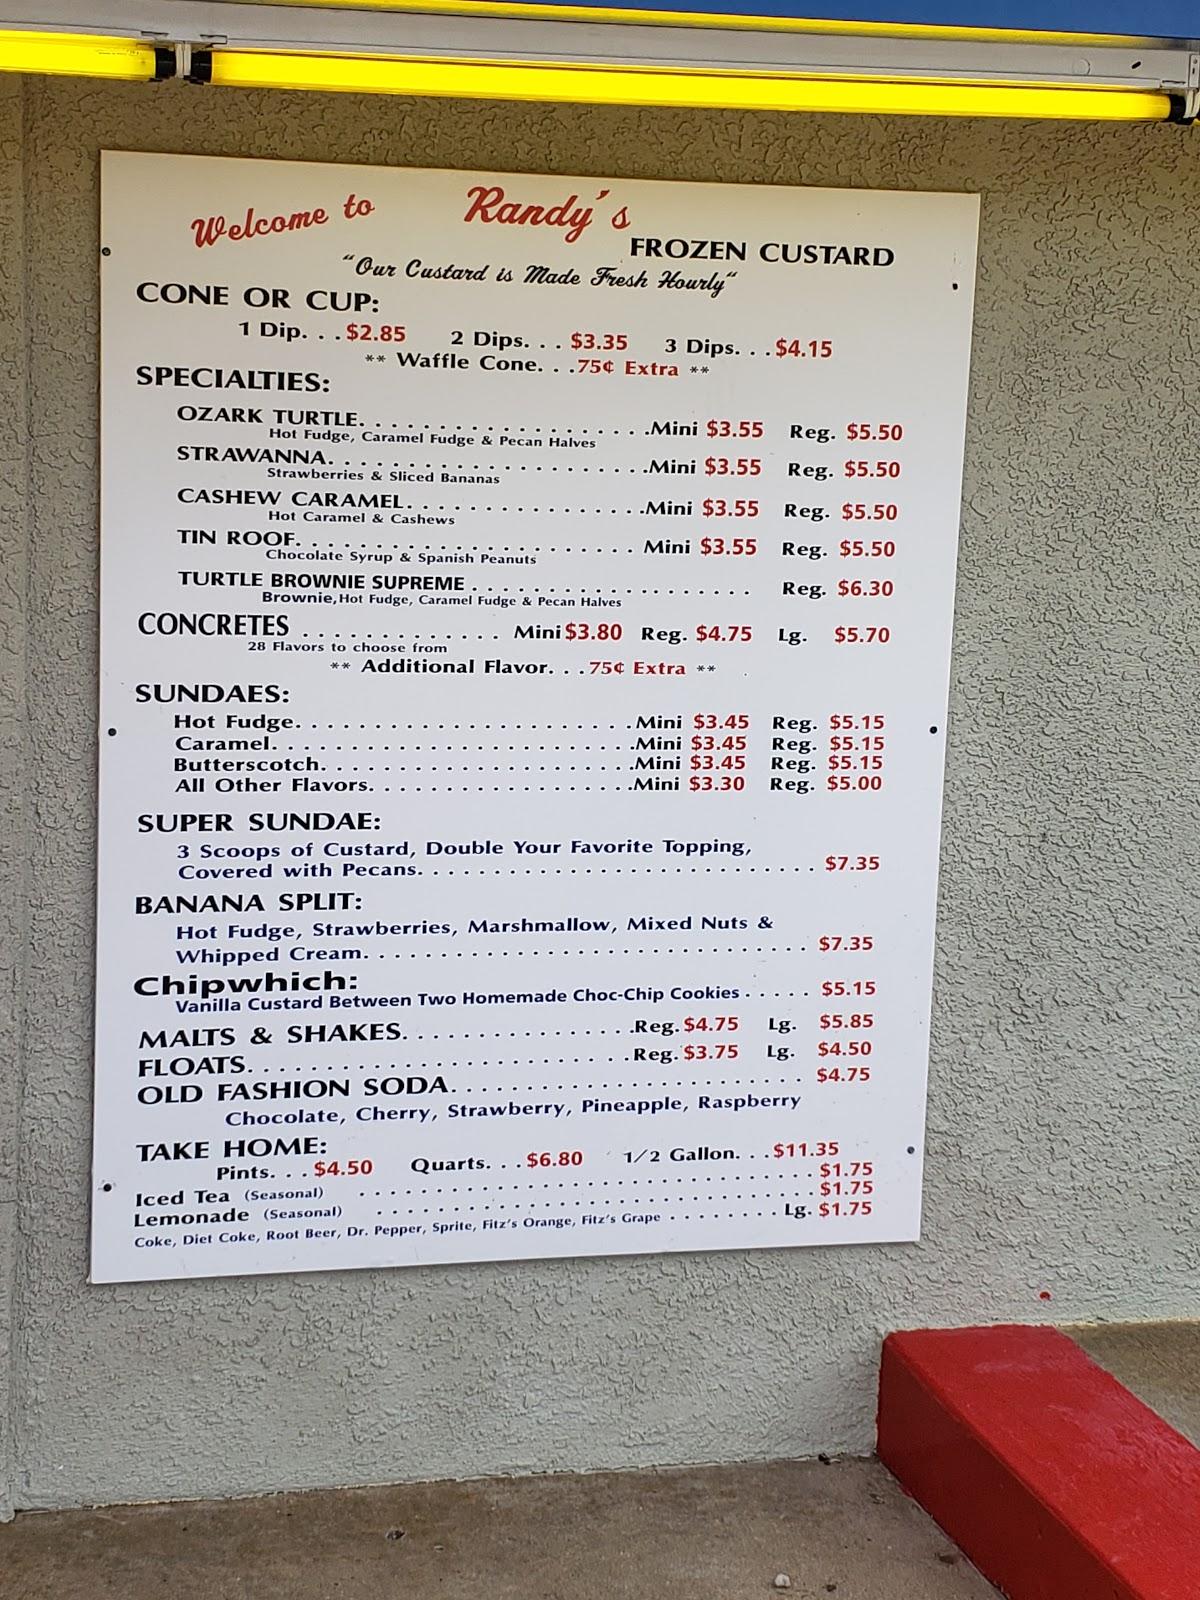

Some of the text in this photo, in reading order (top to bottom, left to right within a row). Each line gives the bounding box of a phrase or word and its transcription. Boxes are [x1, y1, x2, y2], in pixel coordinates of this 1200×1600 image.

[190, 193, 376, 249] Welcome to
[630, 237, 895, 267] FROZEN CUSTARD
[405, 258, 490, 282] Custard
[495, 267, 514, 283] is
[523, 265, 582, 286] Made
[590, 266, 649, 288] Fresh
[136, 281, 379, 314] CONE OR CUP:
[238, 321, 406, 343] 1 Dip $2.85
[396, 351, 679, 377] Waffle Cone 75¢ Extra
[136, 365, 330, 393] SPECIALTIES:
[176, 405, 903, 444] OZARK TURTLE Mini $3.55 Reg. $5.50
[269, 427, 596, 449] Hot Fudge, Caramel Fudge & Pecan Halves
[176, 445, 327, 465] STRAWANNA
[266, 467, 500, 485] Strawberries & Sliced Bananas
[177, 487, 404, 509] CASHEW CARAMEL
[176, 529, 296, 547] TIN ROOF
[265, 548, 537, 566] Chocolate Syrup & Spanish Peanuts
[177, 571, 465, 591] TURTLE BROWNIE SUPREME
[137, 612, 752, 646] CONCRETES Mini $3.80 Reg. $4.75
[247, 640, 448, 653] 28 Flavors to choose from
[135, 683, 290, 704] SUNDAES:
[174, 712, 885, 734] Hot Fudge Mini $3.45 Reg. $5.15
[175, 735, 270, 752] Caramel
[173, 756, 319, 772] Butterscotch
[174, 777, 368, 793] All Other Flavors
[137, 812, 381, 833] SUPER SUNDAE:
[176, 838, 752, 862] 3 Scoops of Custard, Double Your Favorite Topping,
[178, 855, 880, 880] Covered with Pecans $7.35
[135, 892, 362, 915] BANANA SPLIT:
[176, 915, 774, 942] Hot Fudge, Strawberries, Marshmallow, Mixed Nuts &
[175, 935, 873, 967] Whipped Cream $7.35
[134, 971, 358, 999] Chipwhich:
[175, 980, 876, 1014] Vanilla Custard Between Two Homemade Choc-Chip Cookies $5.15
[138, 1022, 402, 1050] MALTS & SHAKES
[138, 1055, 246, 1078] FLOATS
[137, 1067, 870, 1105] OLD FASHION SODA $4.75
[225, 1093, 802, 1127] Chocolate, Cherry, Strawberry, Pineapple, Raspberry
[135, 1136, 327, 1163] TAKE HOME:
[623, 1141, 839, 1164] 1/2 Gallon $11.35
[216, 1159, 373, 1181] Pints $4.50
[135, 1161, 873, 1208] Iced Tea (Seasonal) $1.75
[133, 1180, 874, 1228] Lemonade (Seasonal) $1.75
[134, 1201, 872, 1248] Coke, Diet Coke, Root Beer, Dr. Pepper, Sprite, Fitz's Orange, Fitz's Grape Lg. $1.75
